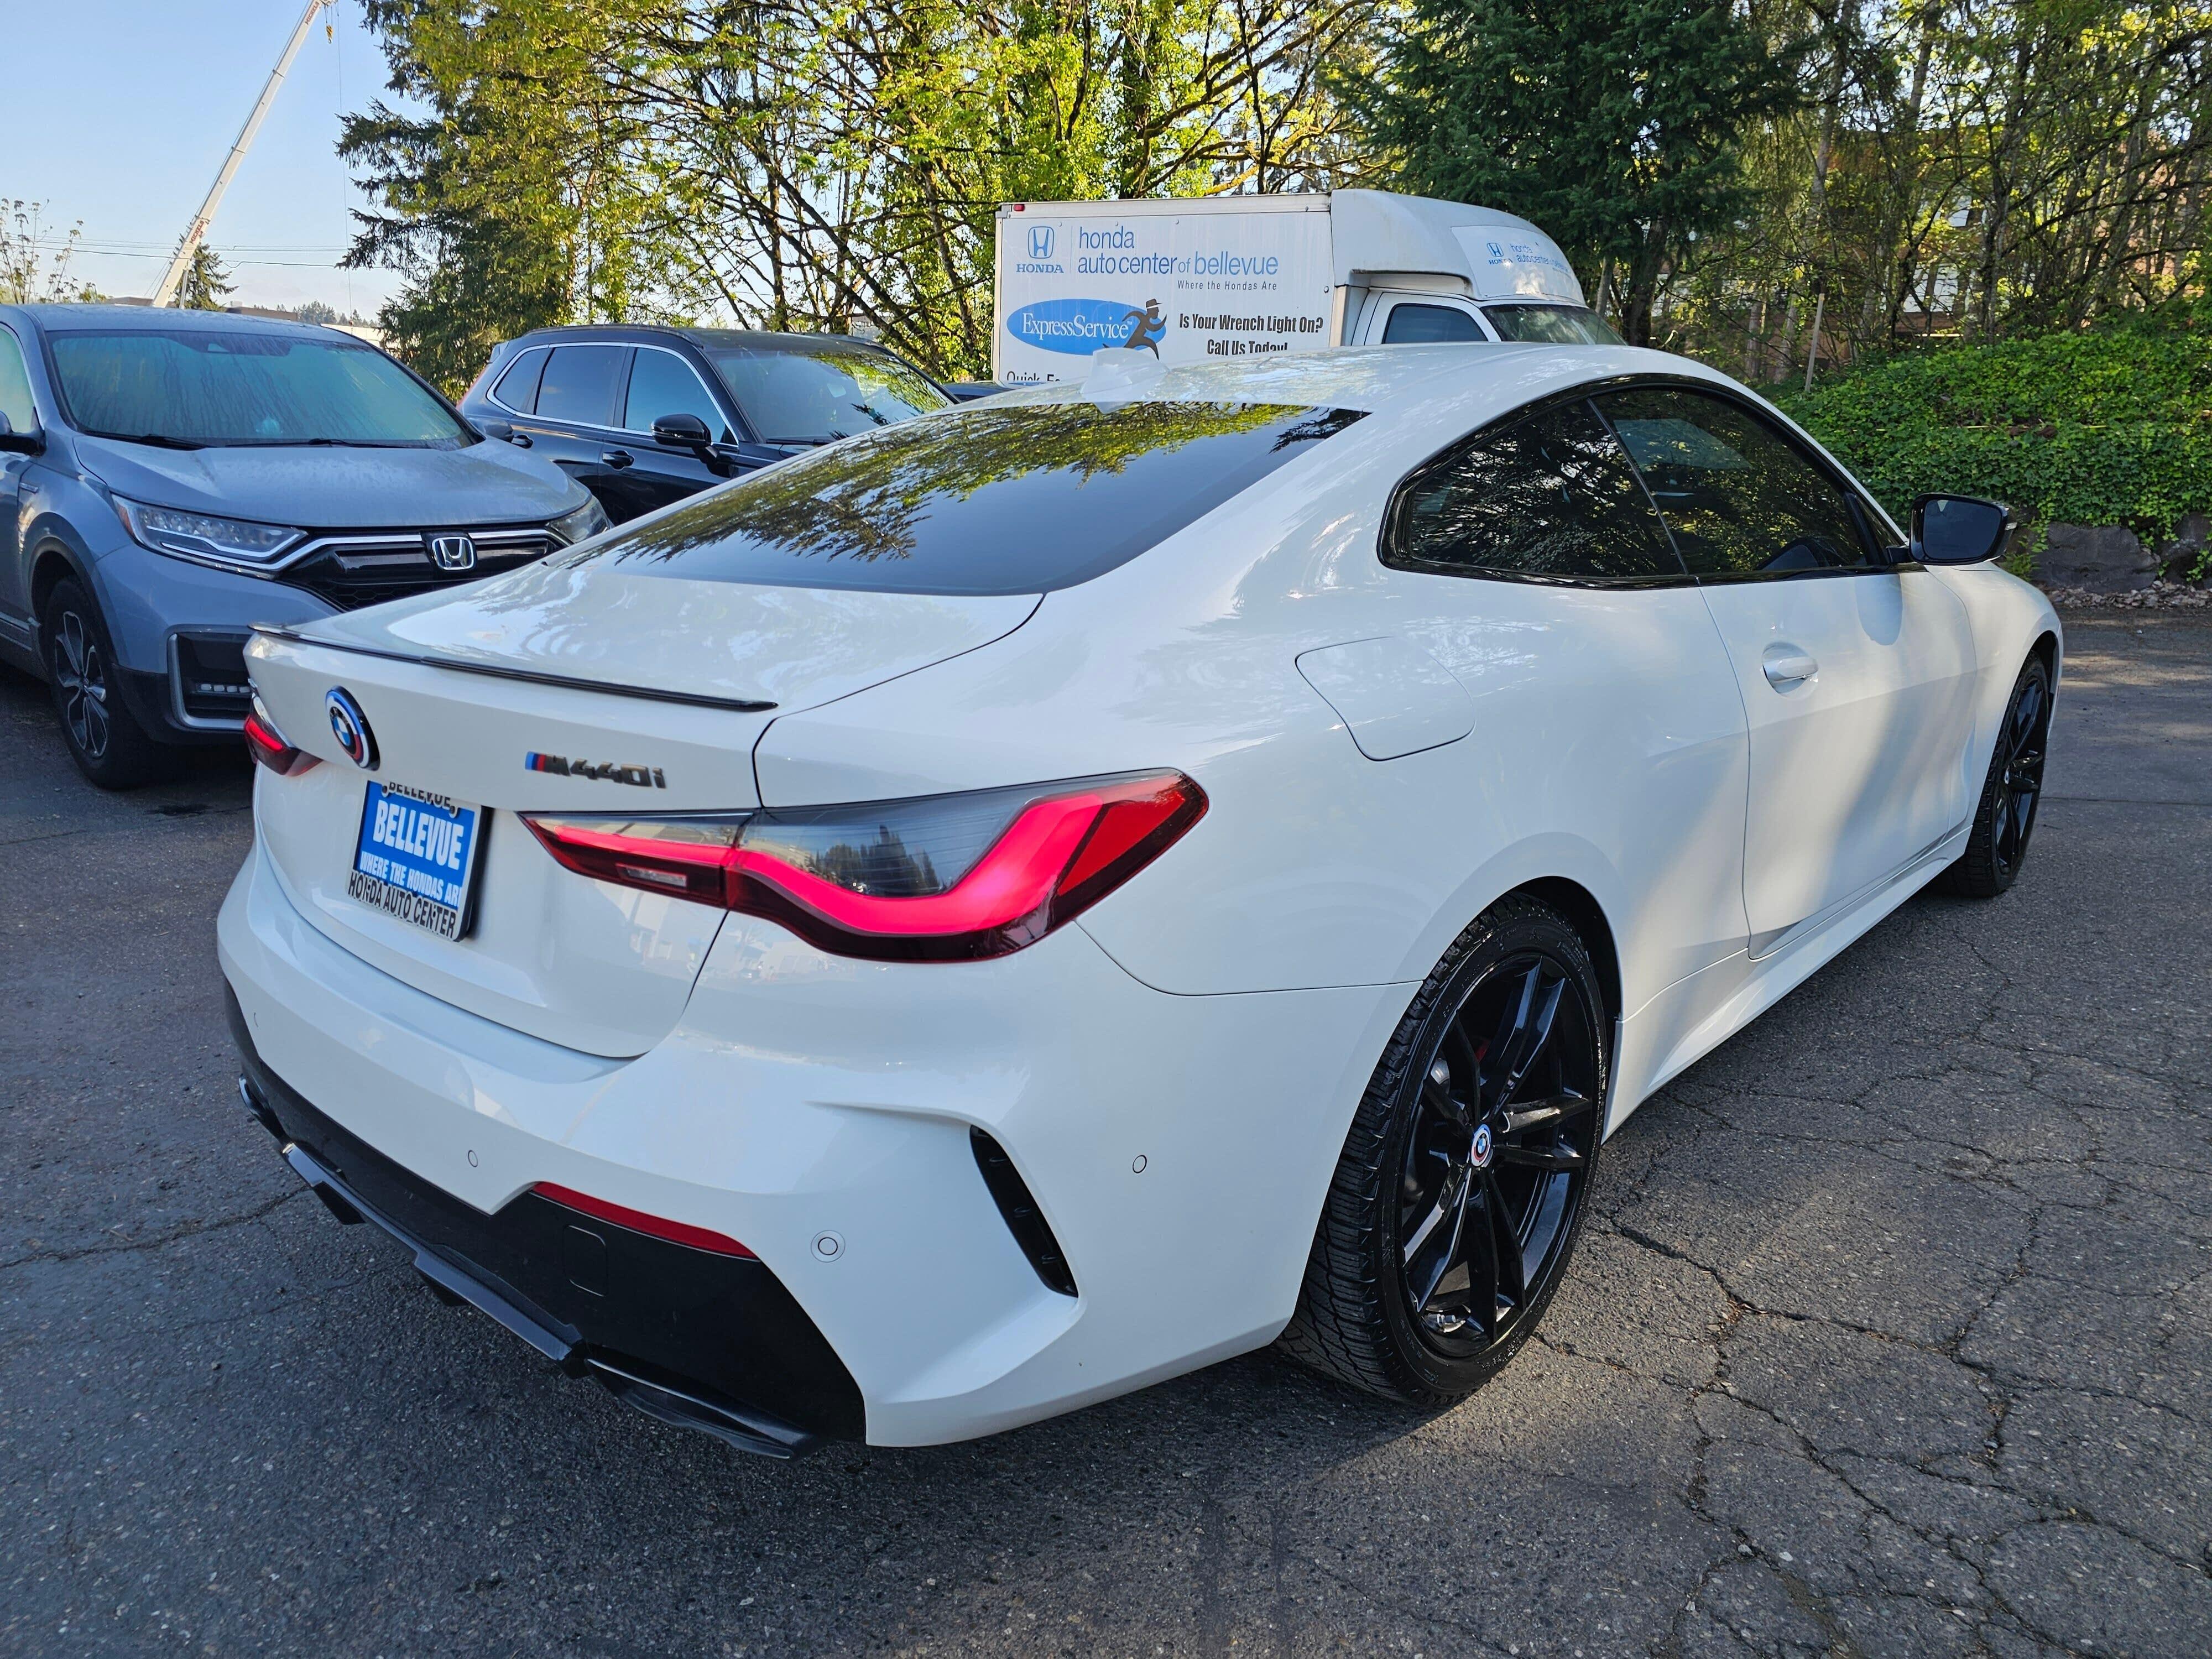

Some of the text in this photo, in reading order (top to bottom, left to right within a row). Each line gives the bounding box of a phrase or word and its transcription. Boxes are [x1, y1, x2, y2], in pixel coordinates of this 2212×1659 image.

[1079, 226, 1134, 249] honda
[1016, 264, 1064, 274] HONDA
[1178, 258, 1191, 273] of
[1194, 251, 1279, 275] bellevue
[1178, 280, 1277, 290] Where the Hondas Are
[1022, 313, 1128, 340] ExpressService
[1180, 313, 1323, 333] Is Your Wrench Light On?
[1207, 339, 1229, 356] Call
[1232, 341, 1245, 355] Us
[389, 781, 451, 808] BELLEVUE
[373, 800, 464, 870] BELLEVUE
[359, 851, 389, 879] WHERE
[389, 862, 407, 886] THE
[406, 868, 444, 901] HONDAS
[348, 872, 456, 939] HONDA AUTO CENTER
